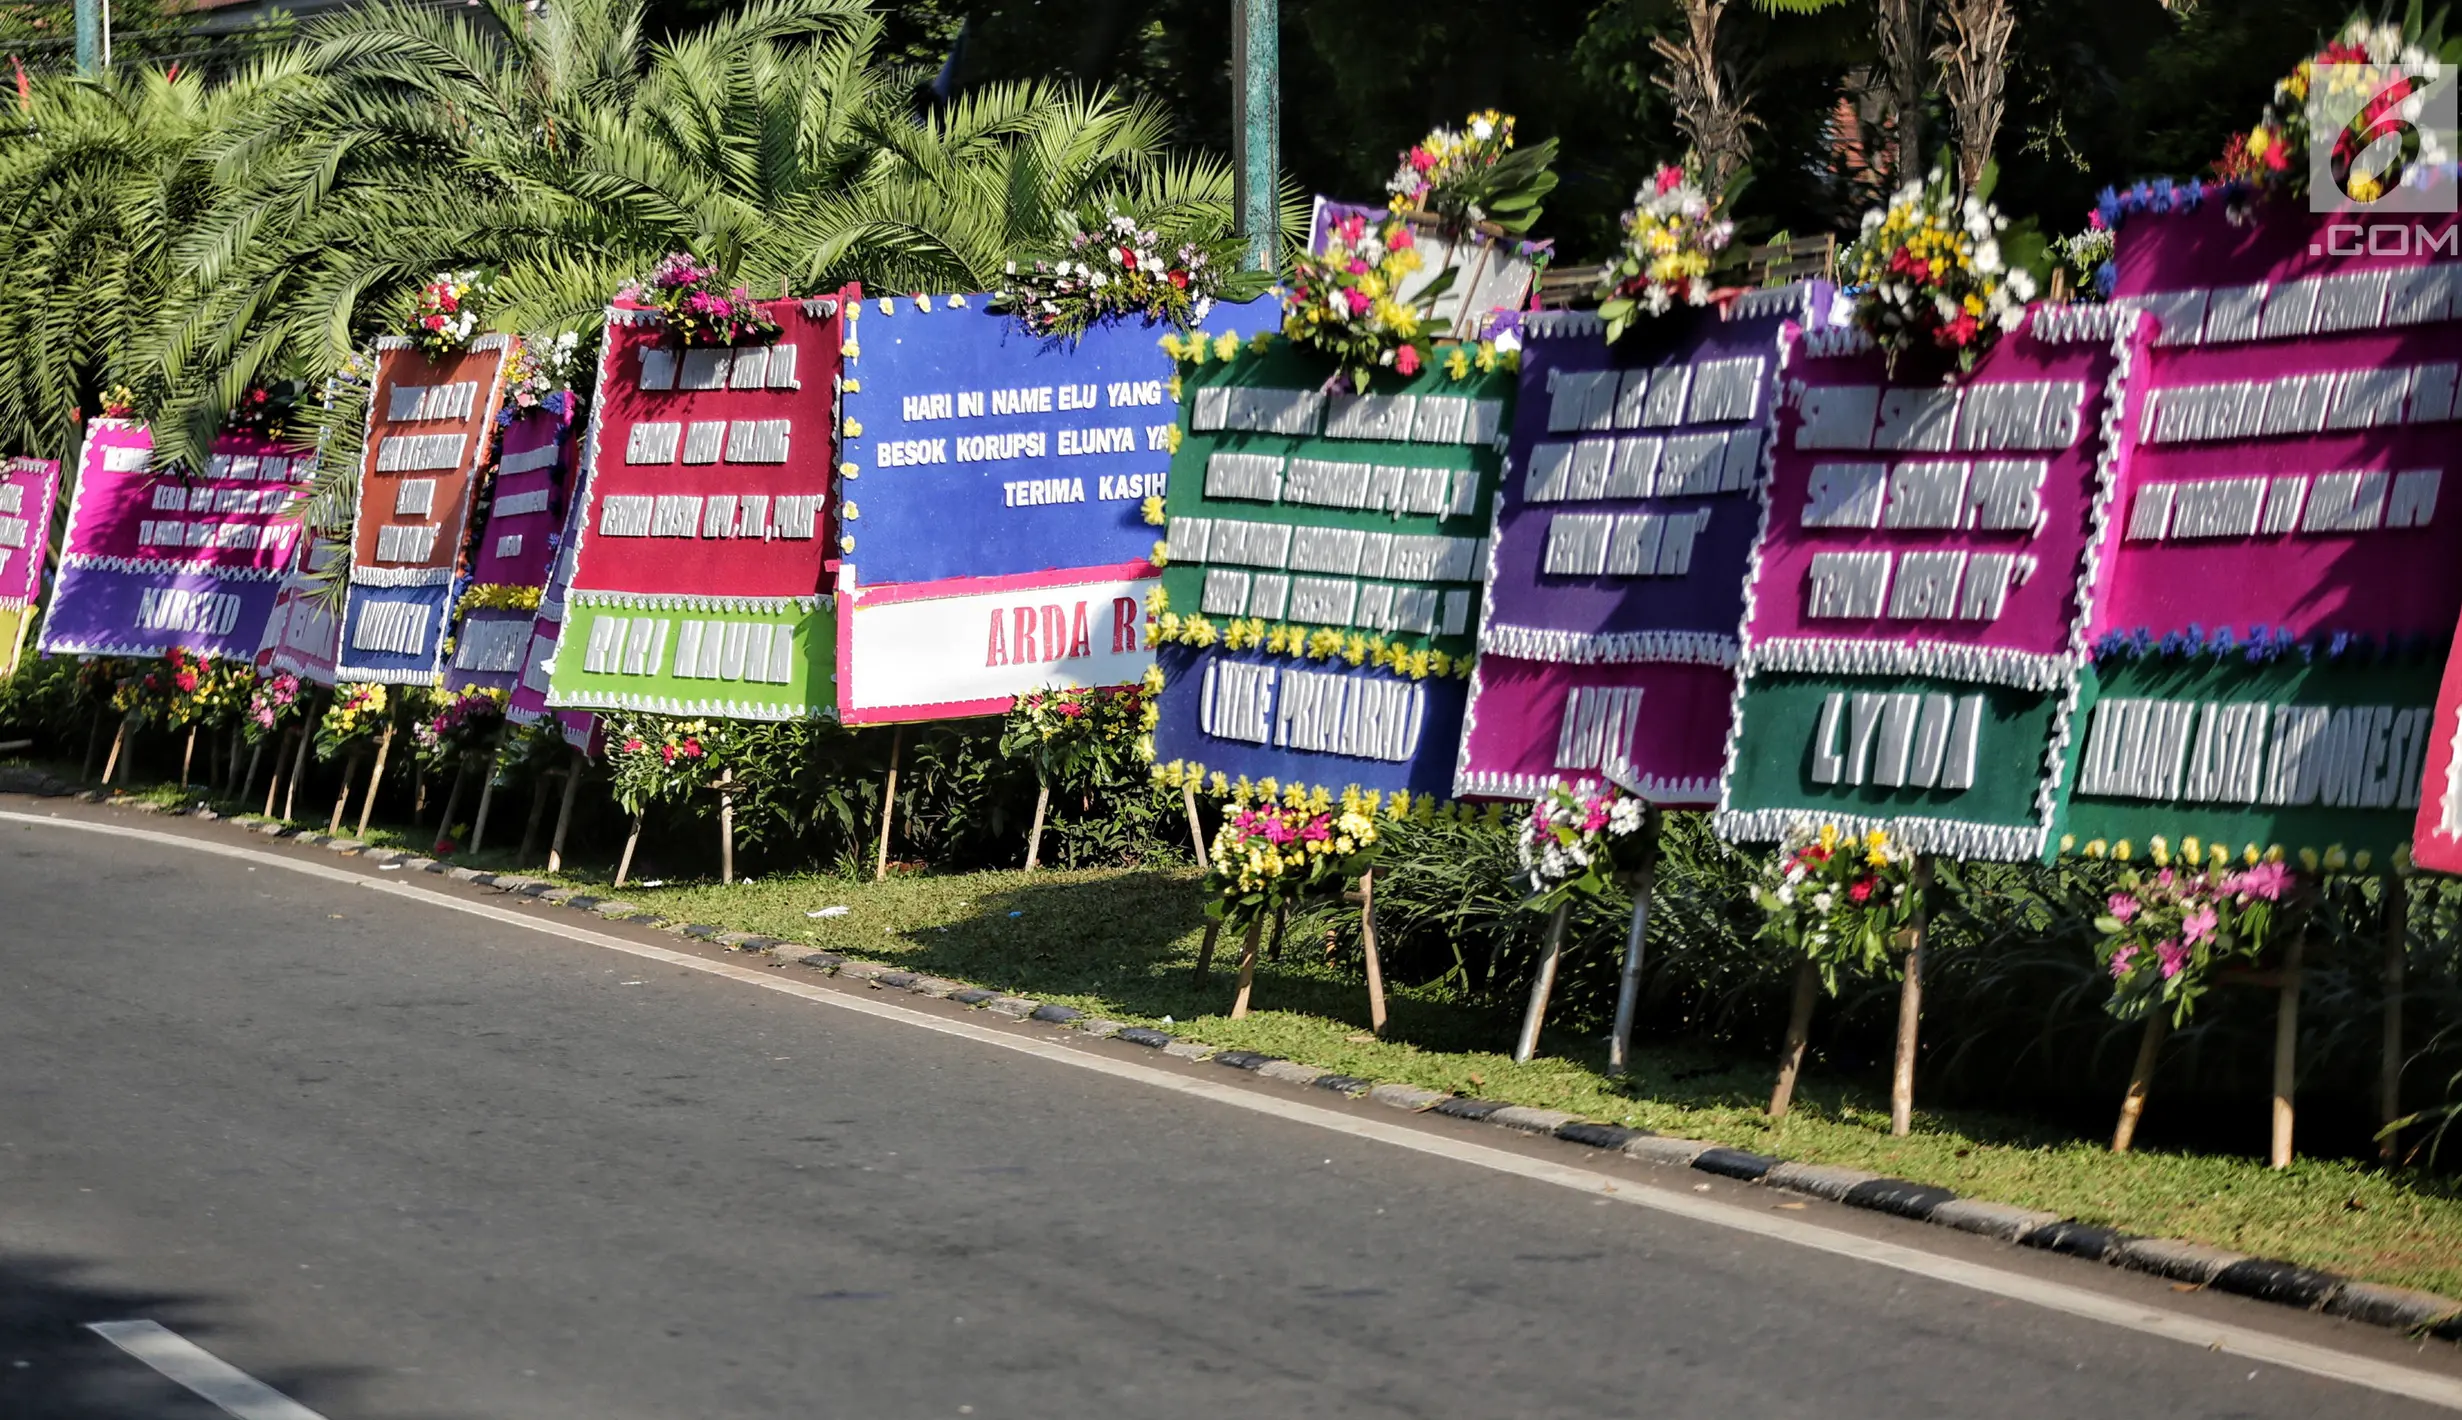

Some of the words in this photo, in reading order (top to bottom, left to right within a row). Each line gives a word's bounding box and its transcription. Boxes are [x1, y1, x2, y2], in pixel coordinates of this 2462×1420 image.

[903, 395, 951, 421] HARI
[957, 392, 984, 418] INI
[992, 388, 1051, 416] NAME
[1058, 384, 1098, 411] ELU
[1107, 380, 1162, 408] YANG
[877, 438, 946, 468] BESOK
[956, 433, 1046, 462] KORUPSI
[1058, 427, 1135, 456] ELUNYA
[1004, 477, 1085, 507] TERIMA
[1098, 472, 1167, 500] KASIH
[583, 615, 670, 676] RIRI
[986, 600, 1091, 667] ARDA
[1812, 692, 1983, 789] LYNDA
[2184, 700, 2269, 804] ASIA
